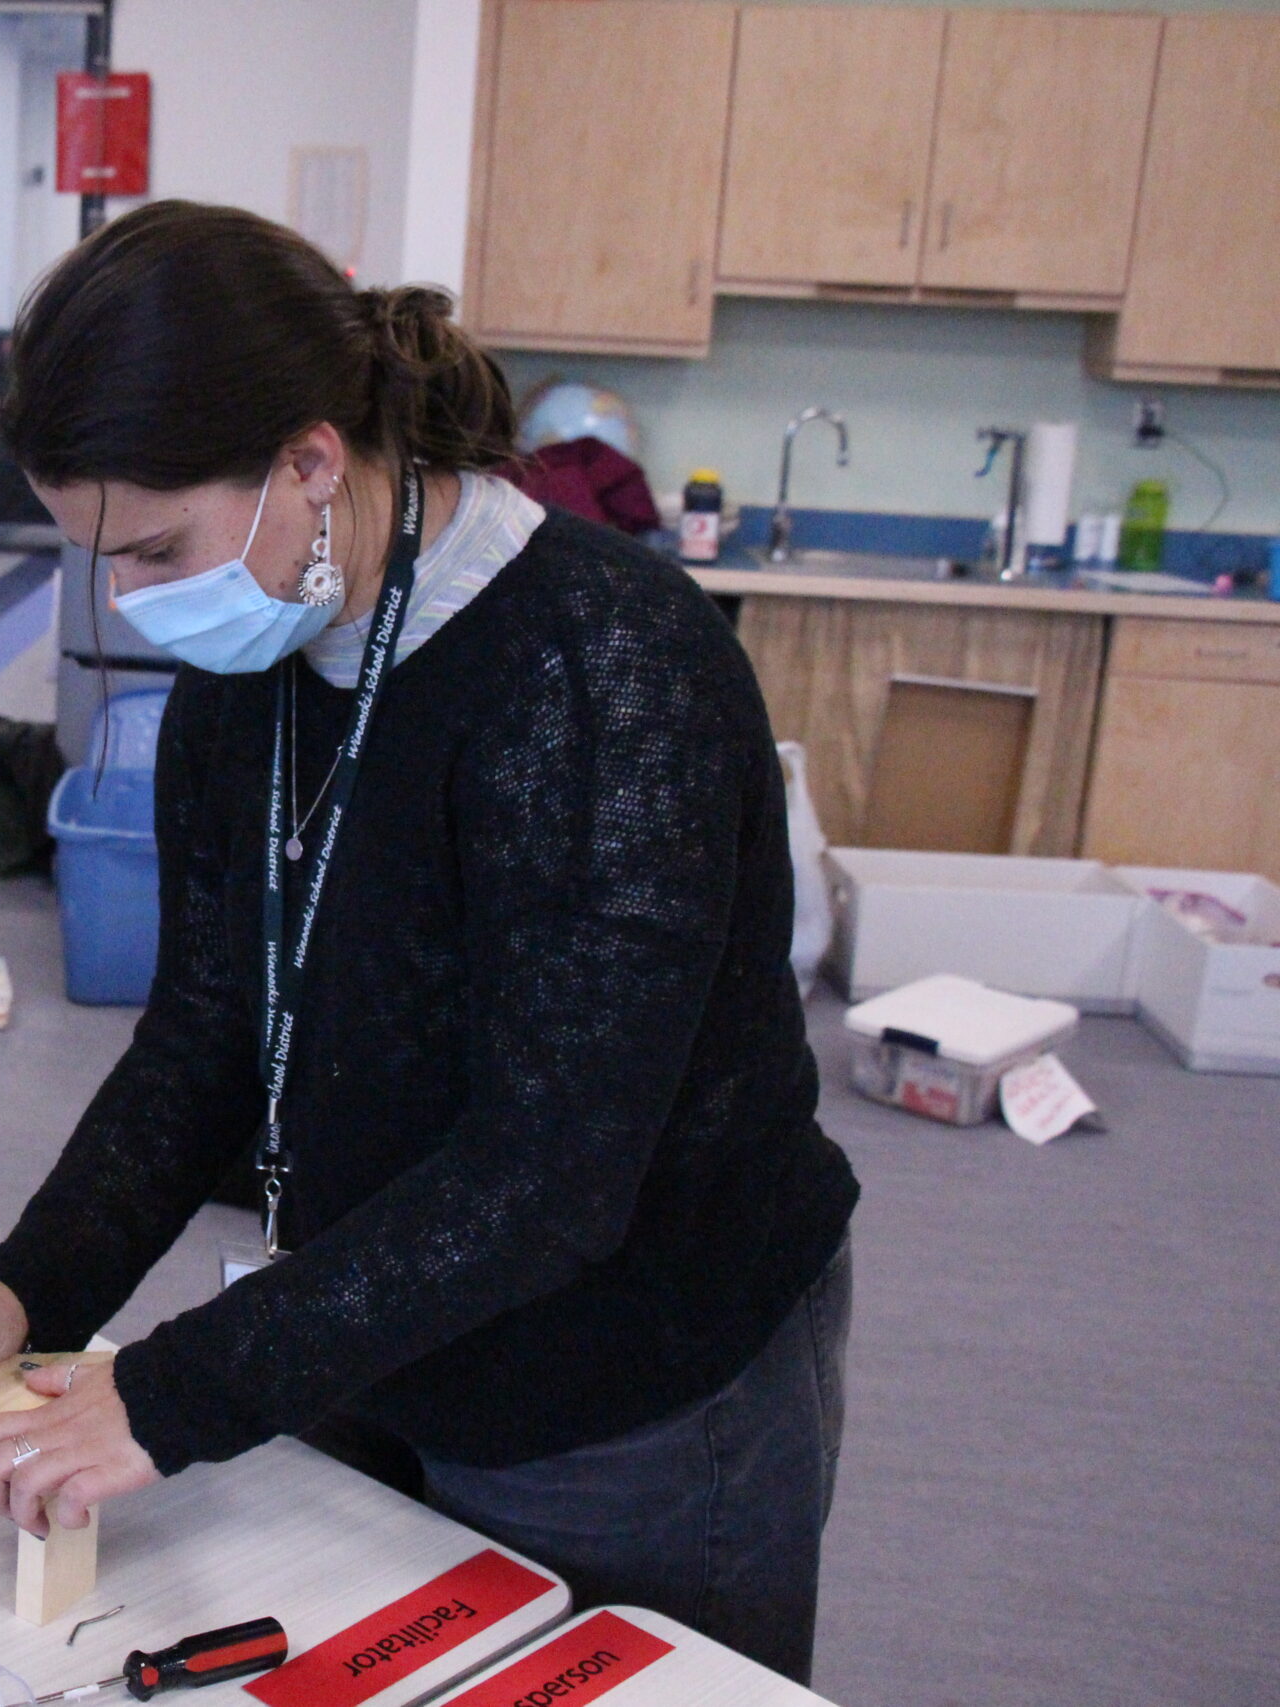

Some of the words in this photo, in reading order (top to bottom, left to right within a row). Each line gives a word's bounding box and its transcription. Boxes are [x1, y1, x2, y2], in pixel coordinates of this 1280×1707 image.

[375, 585, 403, 644] District
[364, 644, 387, 694] School
[347, 692, 373, 760] Winooski
[269, 789, 282, 834] School
[267, 837, 279, 892] District
[293, 906, 315, 969] Winooski
[309, 858, 327, 907] School
[321, 803, 342, 860] District
[267, 940, 281, 1006] Winooski
[274, 1010, 294, 1062] District
[341, 1597, 477, 1679] Facilitator
